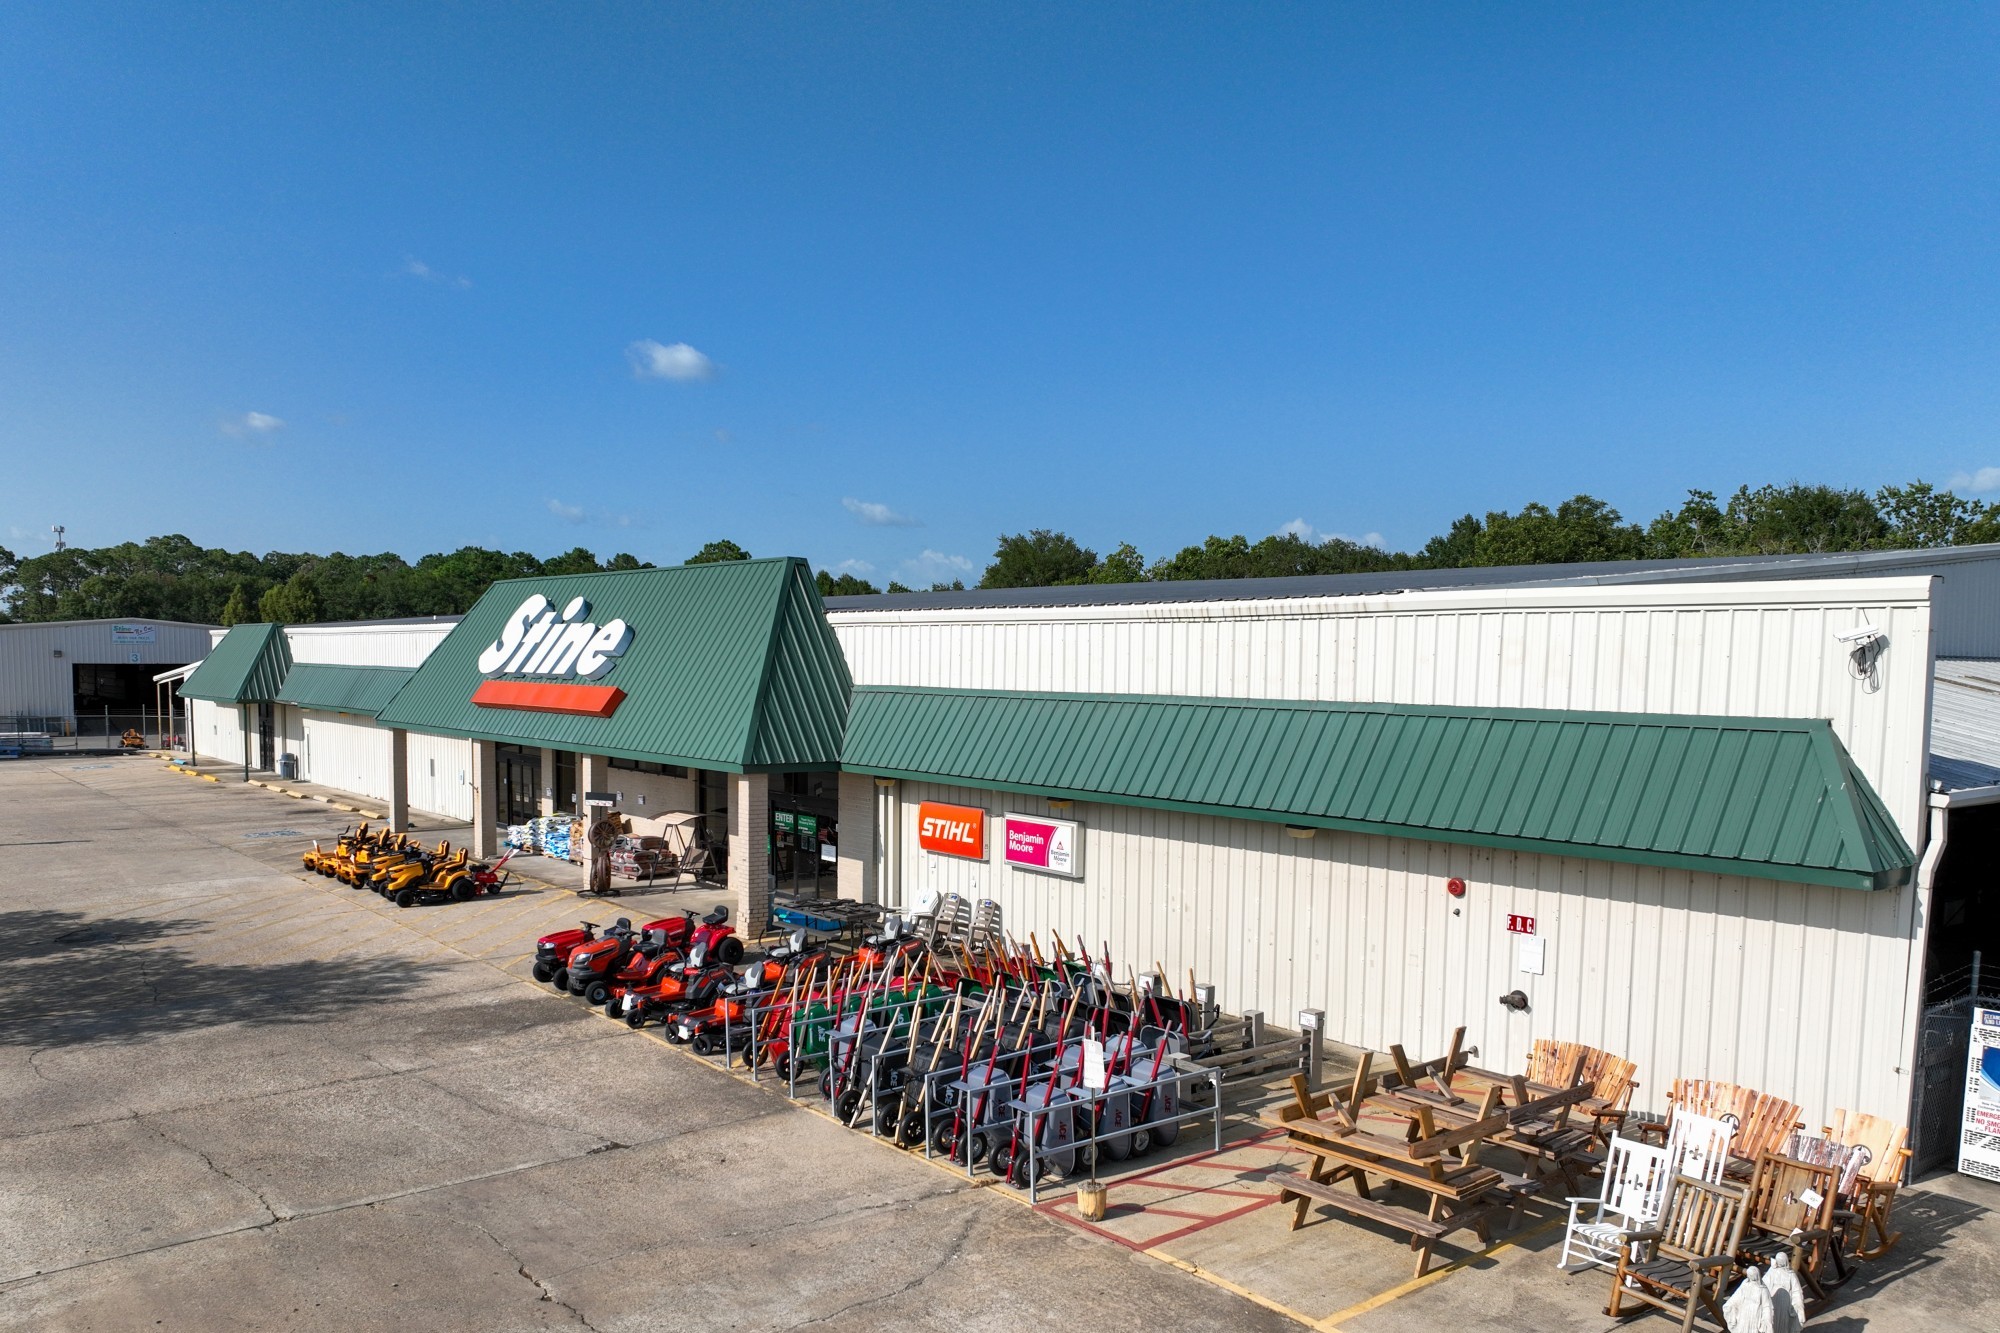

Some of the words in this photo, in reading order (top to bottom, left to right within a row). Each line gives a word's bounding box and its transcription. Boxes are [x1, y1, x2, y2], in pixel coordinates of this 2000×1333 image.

[478, 594, 631, 679] Stine
[131, 653, 139, 662] 3
[775, 812, 794, 824] ENTER
[921, 816, 975, 844] STIHL
[1009, 829, 1044, 845] Benjamin
[1009, 839, 1034, 854] Moore
